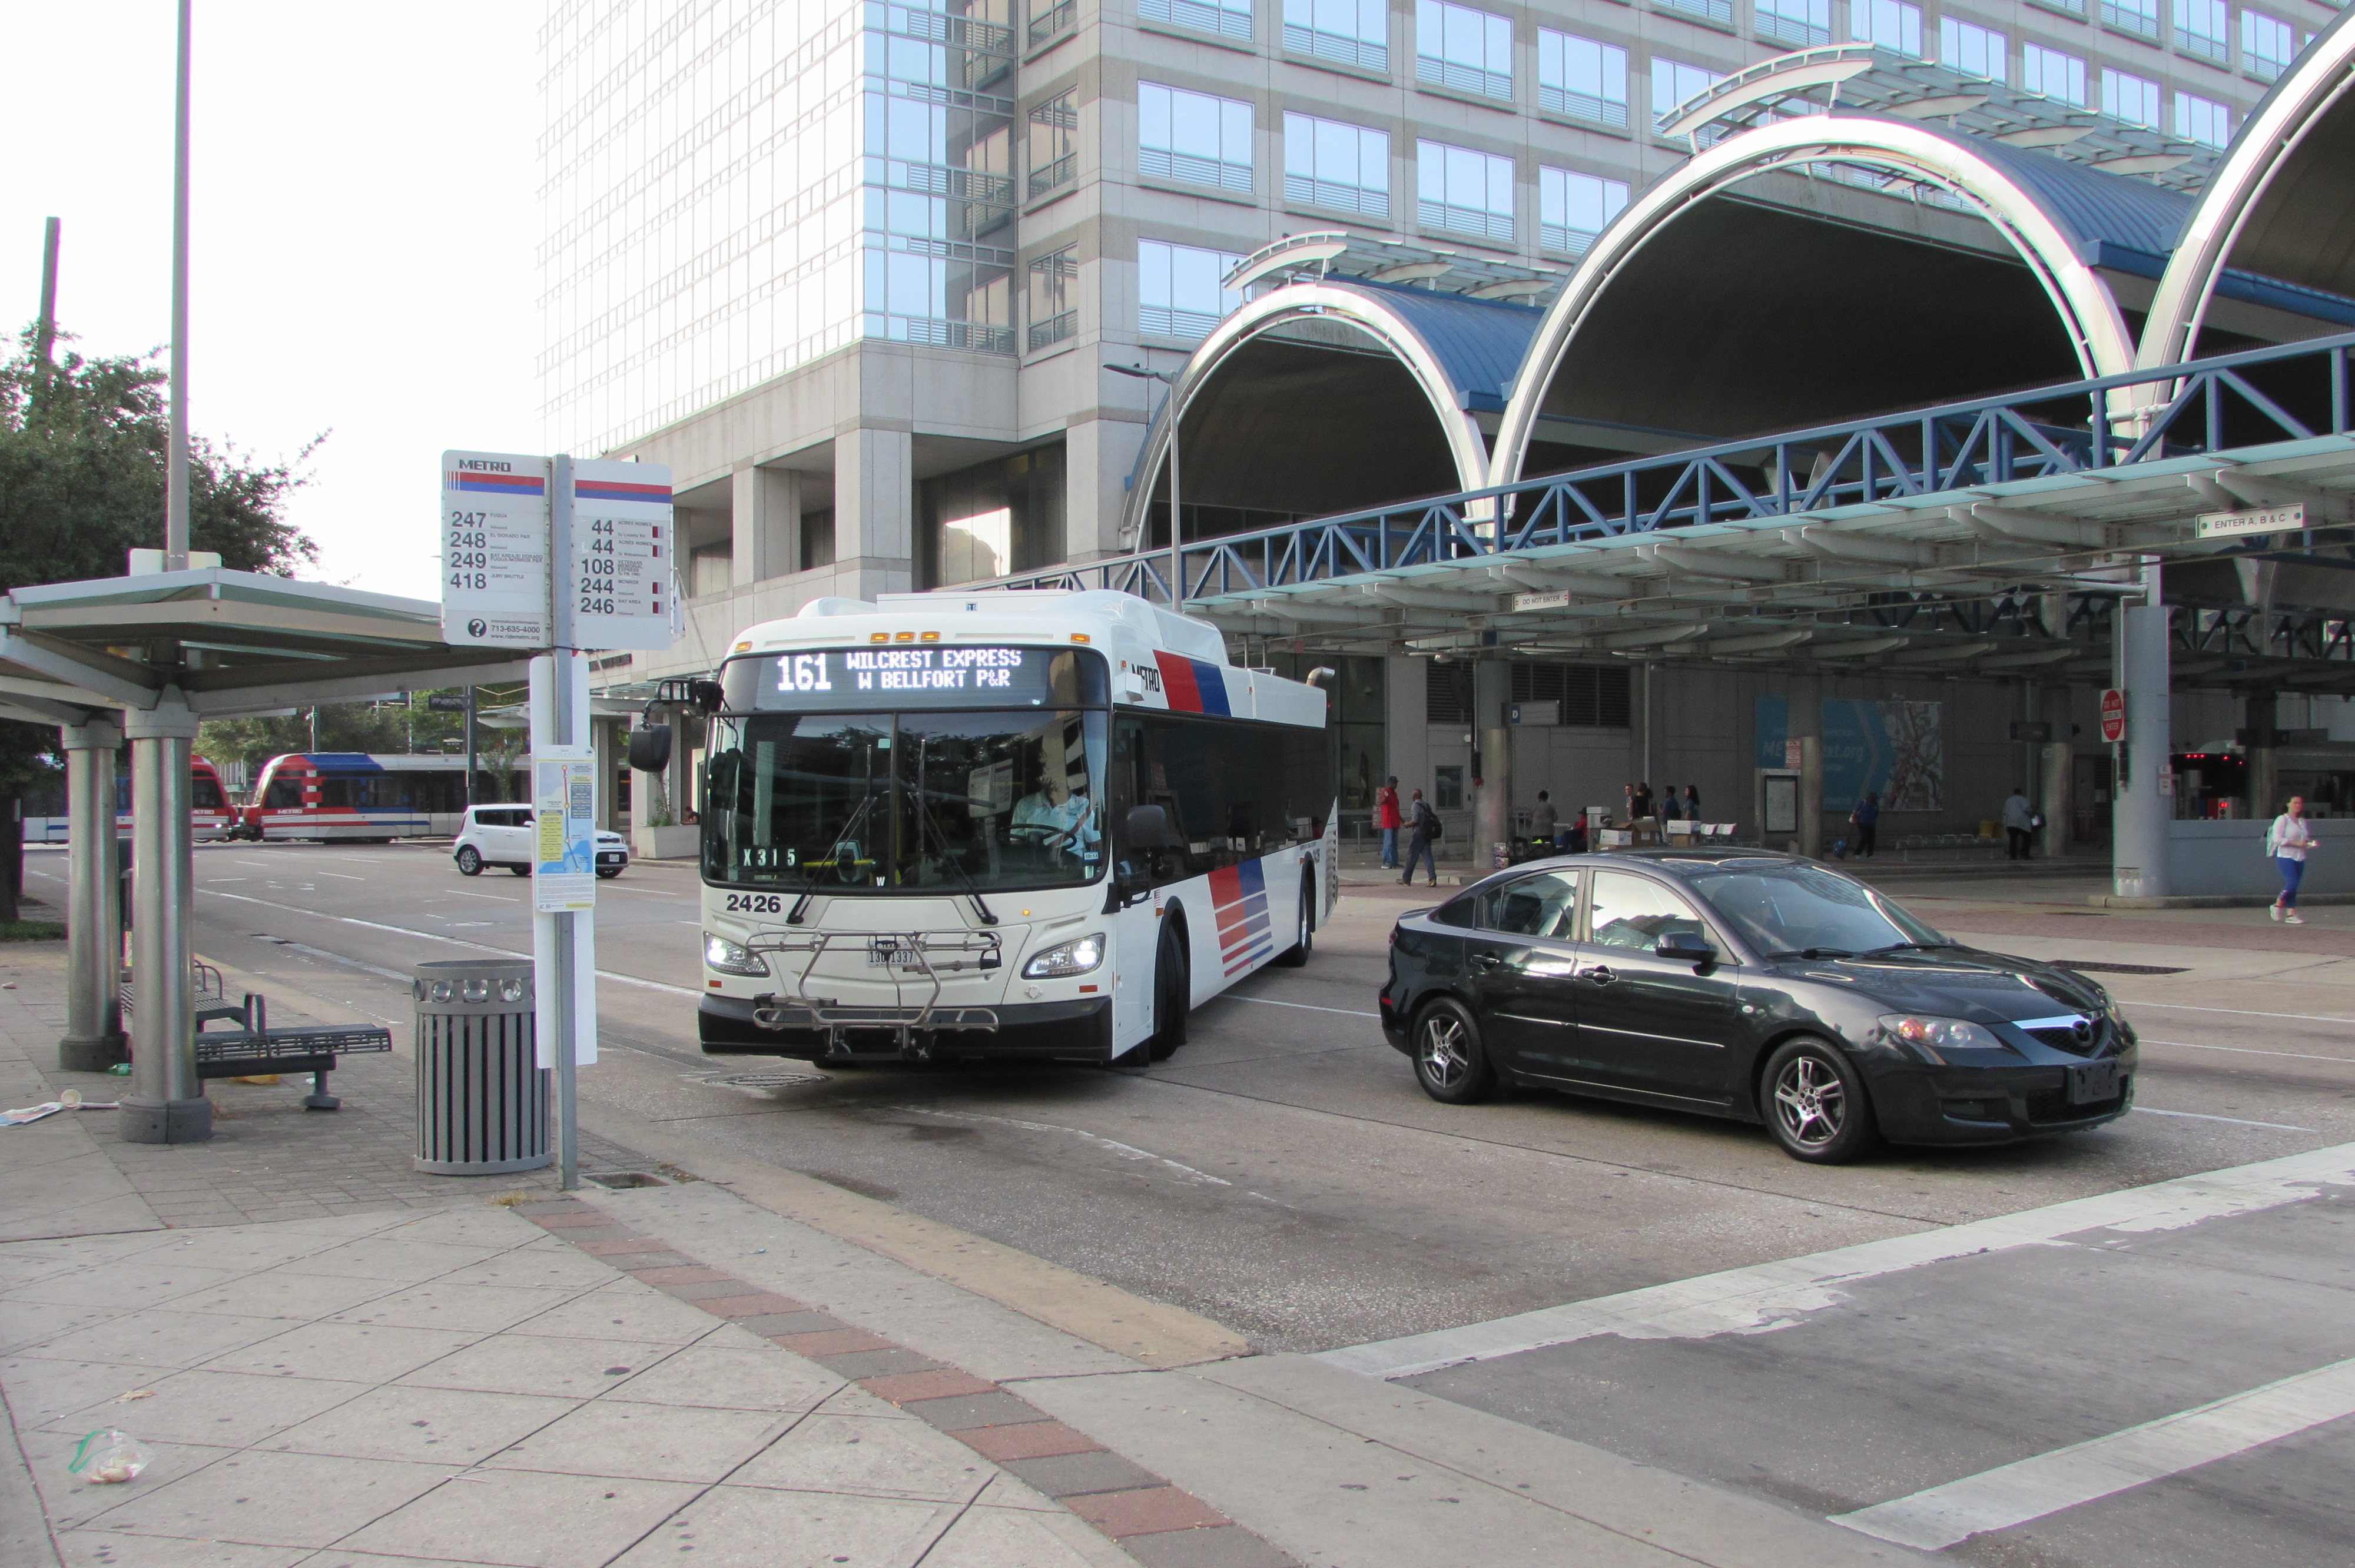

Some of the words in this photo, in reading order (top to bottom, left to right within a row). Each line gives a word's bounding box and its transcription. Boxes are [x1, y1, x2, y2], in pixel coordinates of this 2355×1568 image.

[459, 459, 512, 472] METRO
[452, 511, 487, 528] 247
[592, 519, 614, 536] 44
[2215, 518, 2245, 529] ENTER
[2248, 517, 2257, 525] A,
[2260, 516, 2266, 524] B
[2269, 515, 2276, 523] &
[2278, 514, 2286, 522] C
[450, 531, 487, 549] 248
[592, 539, 614, 554] 44
[451, 552, 487, 569] 249
[582, 559, 614, 575] 108
[450, 573, 487, 589] 418
[581, 577, 614, 594] 244
[581, 597, 614, 614] 246
[491, 624, 540, 633] 713-635-4000
[847, 650, 933, 670] WILCREST
[942, 649, 1022, 667] EXPRESS
[777, 653, 832, 691] 161
[858, 672, 873, 690] W
[881, 670, 967, 689] BELLFORT
[976, 669, 1011, 687] P&R
[1512, 710, 1519, 719] D
[877, 876, 885, 886] W
[727, 893, 781, 913] 2426
[891, 951, 913, 963] 1337
